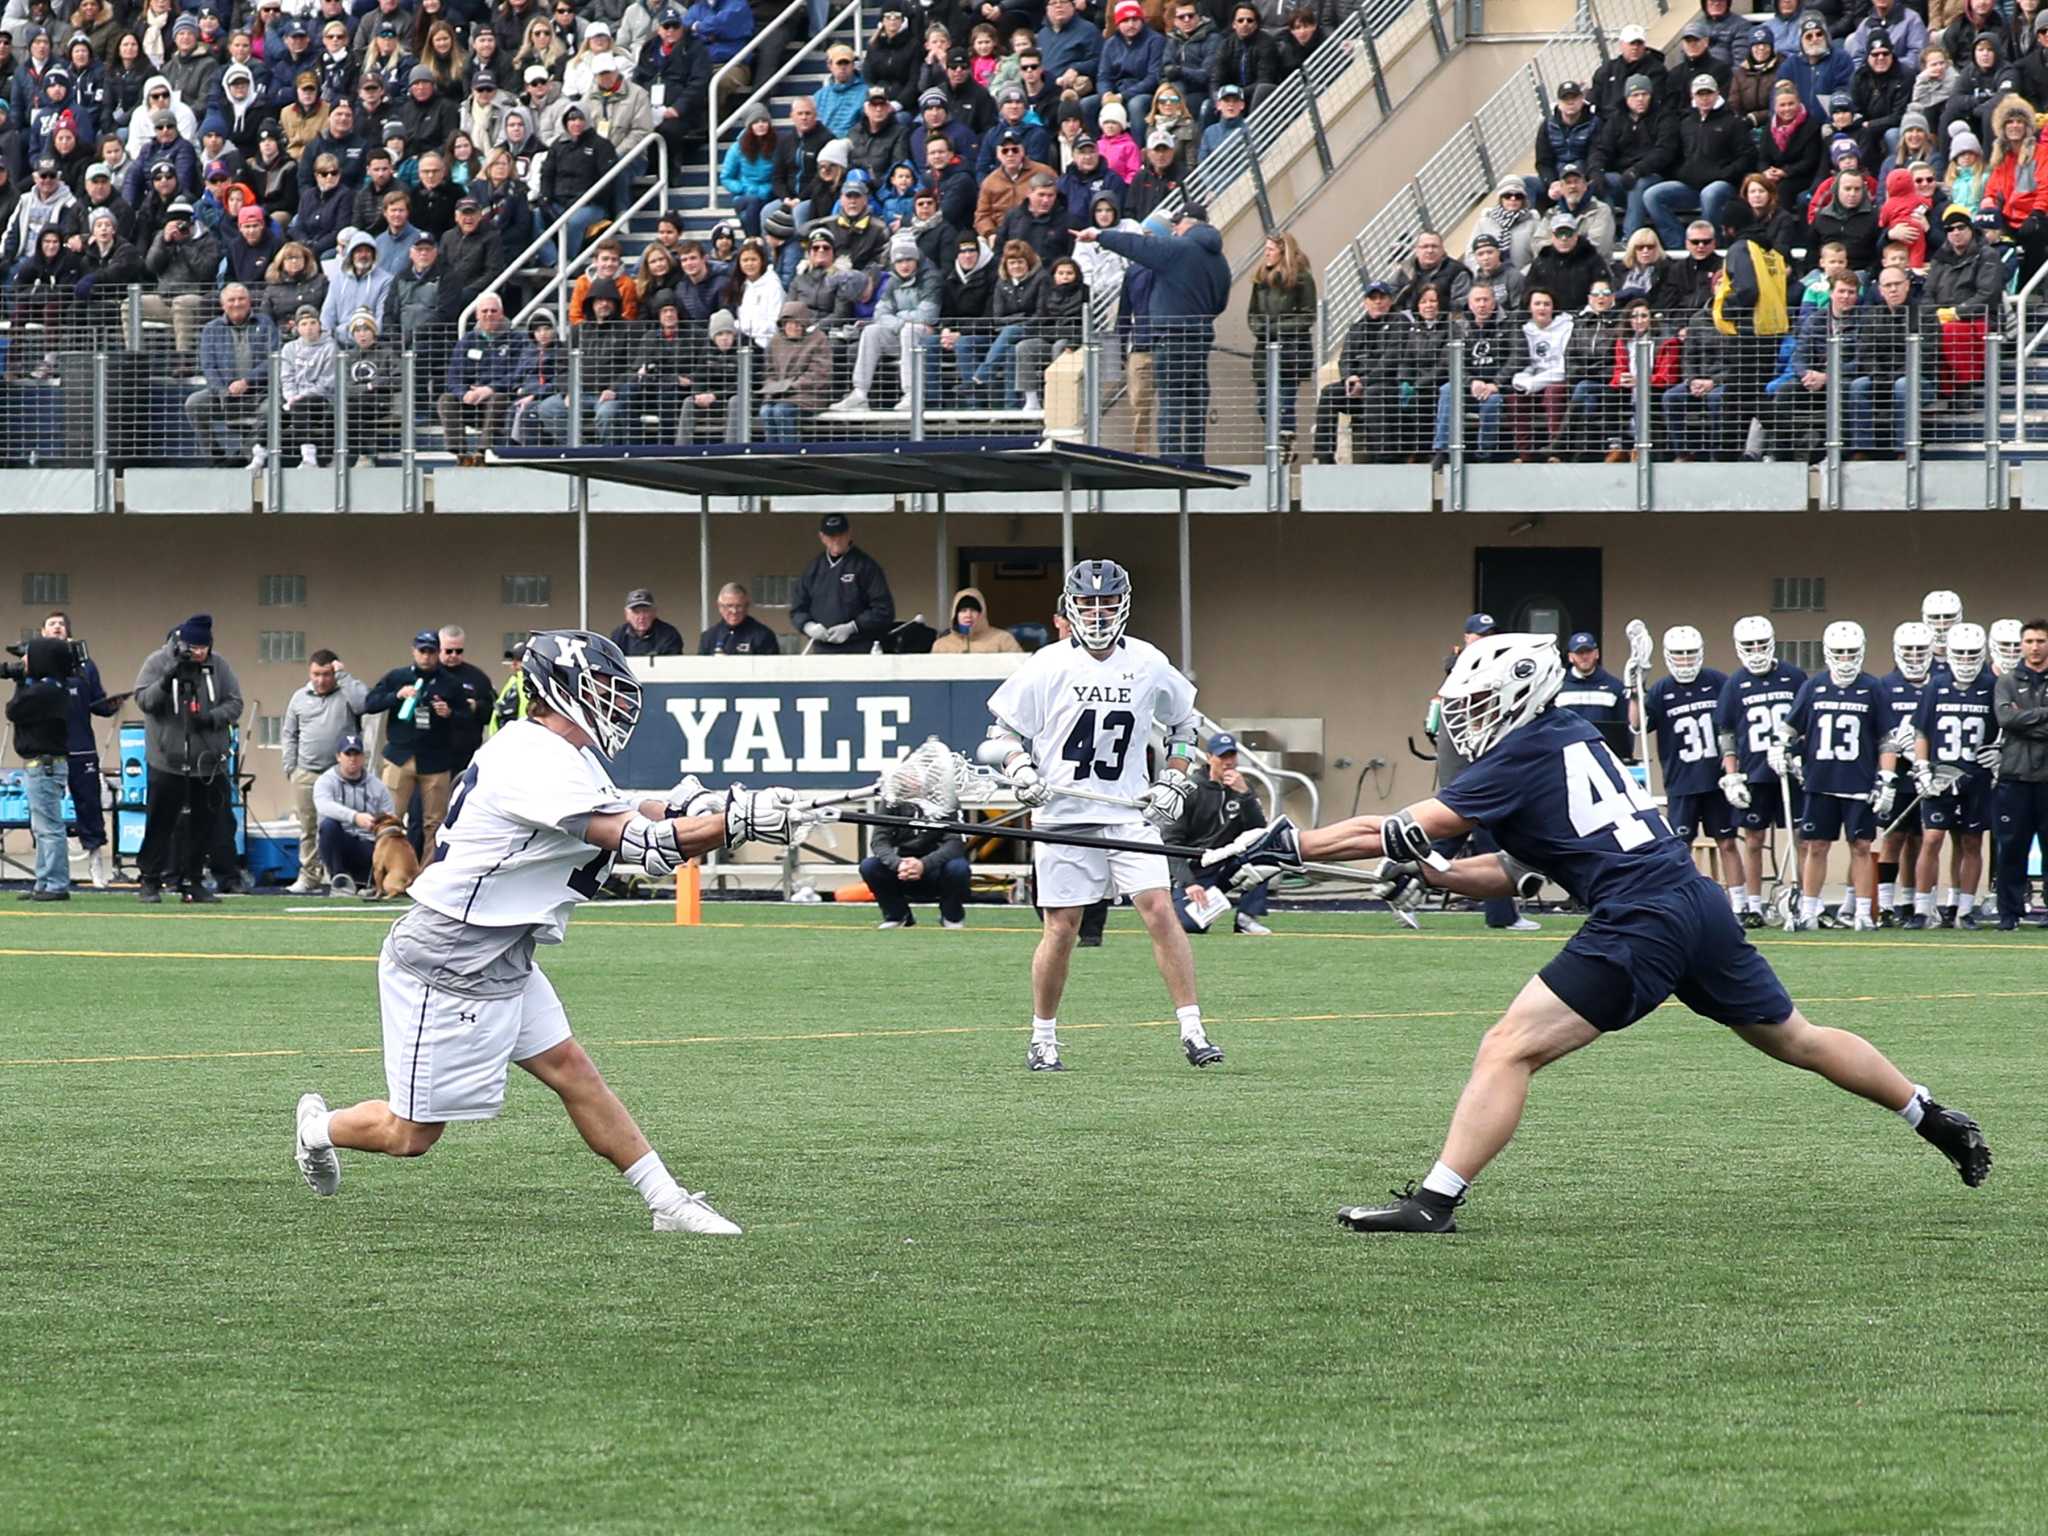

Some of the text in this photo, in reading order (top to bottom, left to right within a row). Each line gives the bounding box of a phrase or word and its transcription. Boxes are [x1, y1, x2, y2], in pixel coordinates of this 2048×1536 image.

[1073, 686, 1131, 703] YALE
[1936, 704, 1990, 713] PENN STATE
[666, 696, 911, 773] YALE
[1062, 709, 1135, 781] 43
[1673, 712, 1718, 763] 31
[1816, 713, 1861, 761] 13
[1937, 715, 1985, 761] 33
